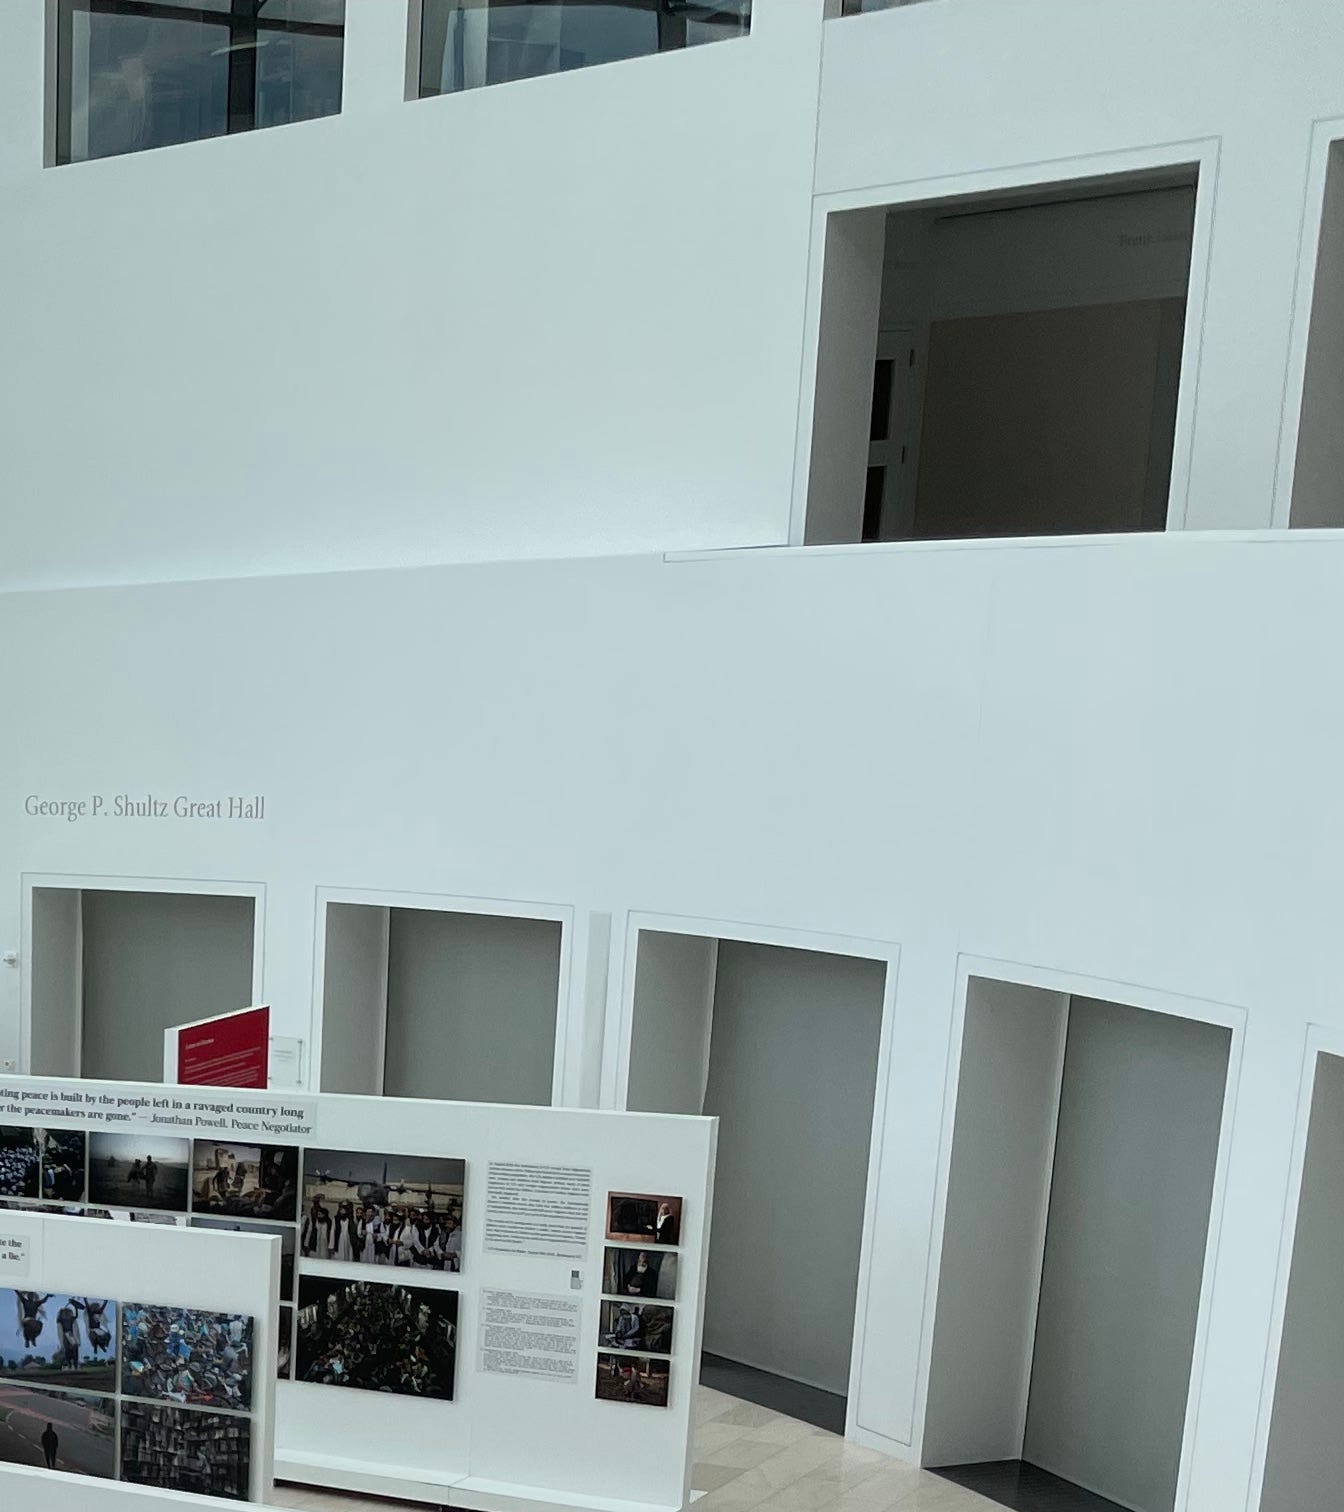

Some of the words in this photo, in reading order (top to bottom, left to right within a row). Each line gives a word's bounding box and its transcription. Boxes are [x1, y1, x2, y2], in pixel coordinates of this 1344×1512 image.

[25, 795, 86, 822] George
[91, 796, 108, 817] P.
[113, 795, 169, 817] Shultz
[173, 796, 221, 818] Great
[228, 797, 265, 819] Hall
[5, 1102, 22, 1114] the
[23, 1106, 86, 1118] peacemakers
[86, 1110, 104, 1120] are
[149, 1112, 193, 1126] Jonathan
[230, 1118, 259, 1131] Peace
[260, 1119, 312, 1135] Negotiator
[20, 1091, 49, 1101] peace
[49, 1090, 59, 1101] is
[59, 1091, 83, 1103] built
[84, 1092, 97, 1106] by
[98, 1093, 115, 1105] the
[116, 1096, 151, 1109] people
[152, 1097, 169, 1108] left
[171, 1098, 183, 1109] in
[183, 1102, 191, 1110] a
[192, 1102, 234, 1114] ravaged
[235, 1105, 278, 1118] country
[279, 1105, 304, 1120] long
